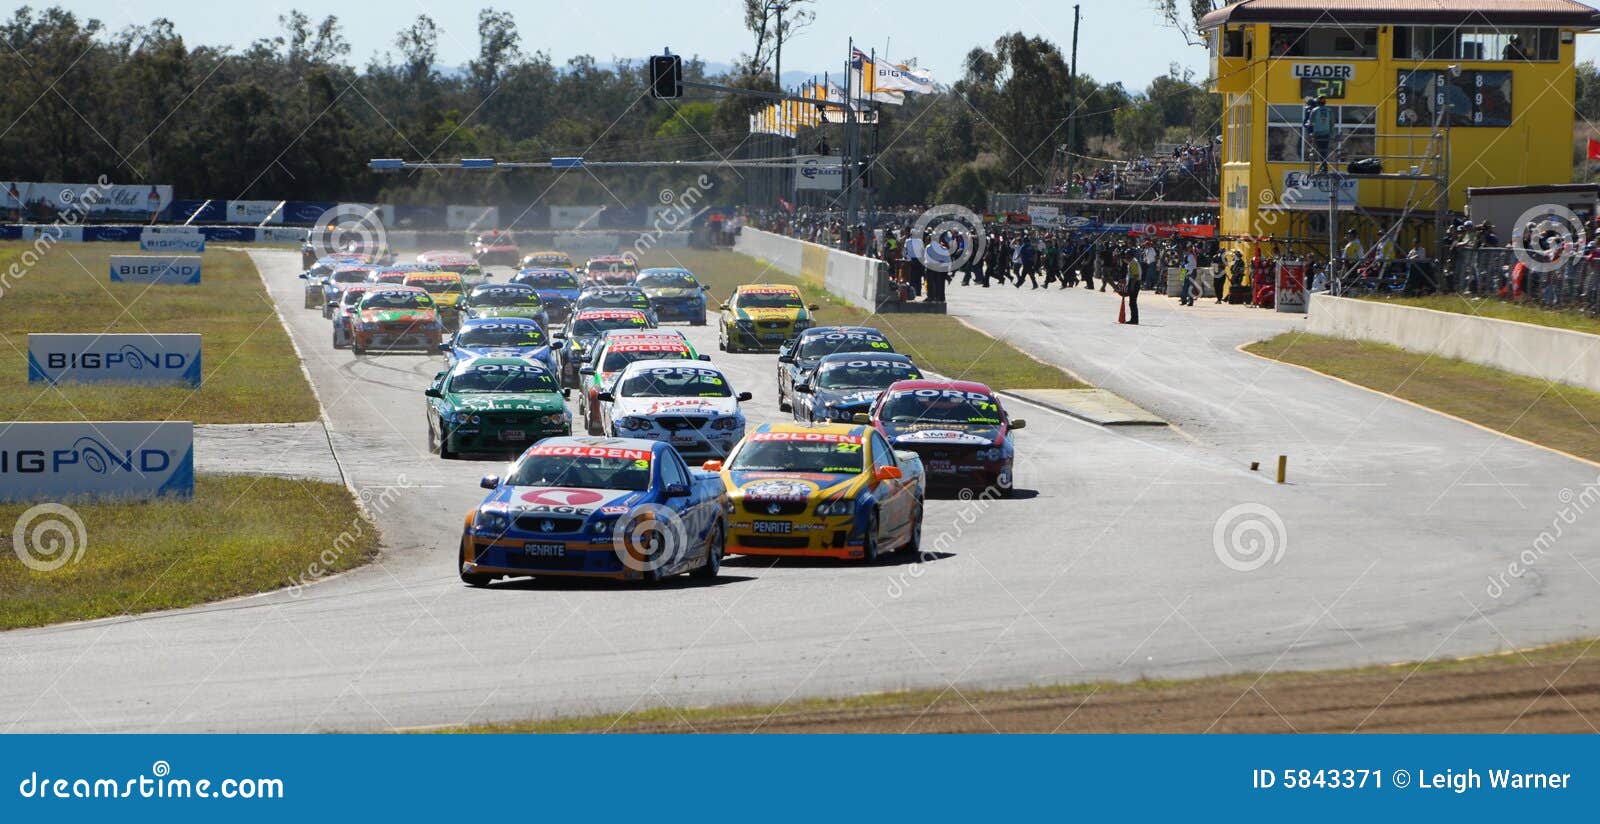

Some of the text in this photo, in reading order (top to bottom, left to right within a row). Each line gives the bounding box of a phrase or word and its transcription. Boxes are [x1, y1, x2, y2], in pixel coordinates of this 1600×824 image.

[1295, 65, 1351, 78] LEADER
[1399, 74, 1484, 87] 2 5 8
[1316, 80, 1343, 97] 27
[1399, 92, 1484, 105] 3 6 9
[1398, 111, 1406, 123] 4
[120, 262, 193, 276] BIGPOND
[808, 333, 884, 343] FORD
[612, 344, 685, 352] HOLDEN
[48, 345, 186, 370] BIGPOND
[824, 360, 912, 370] FORD
[894, 388, 990, 402] FORD
[752, 432, 858, 444] HOLDEN
[536, 446, 643, 459] HOLDEN
[836, 442, 862, 452] 27
[0, 437, 171, 474] IGPOND
[634, 459, 650, 469] 3
[753, 521, 792, 533] PENRITE
[524, 543, 565, 556] PENRITE
